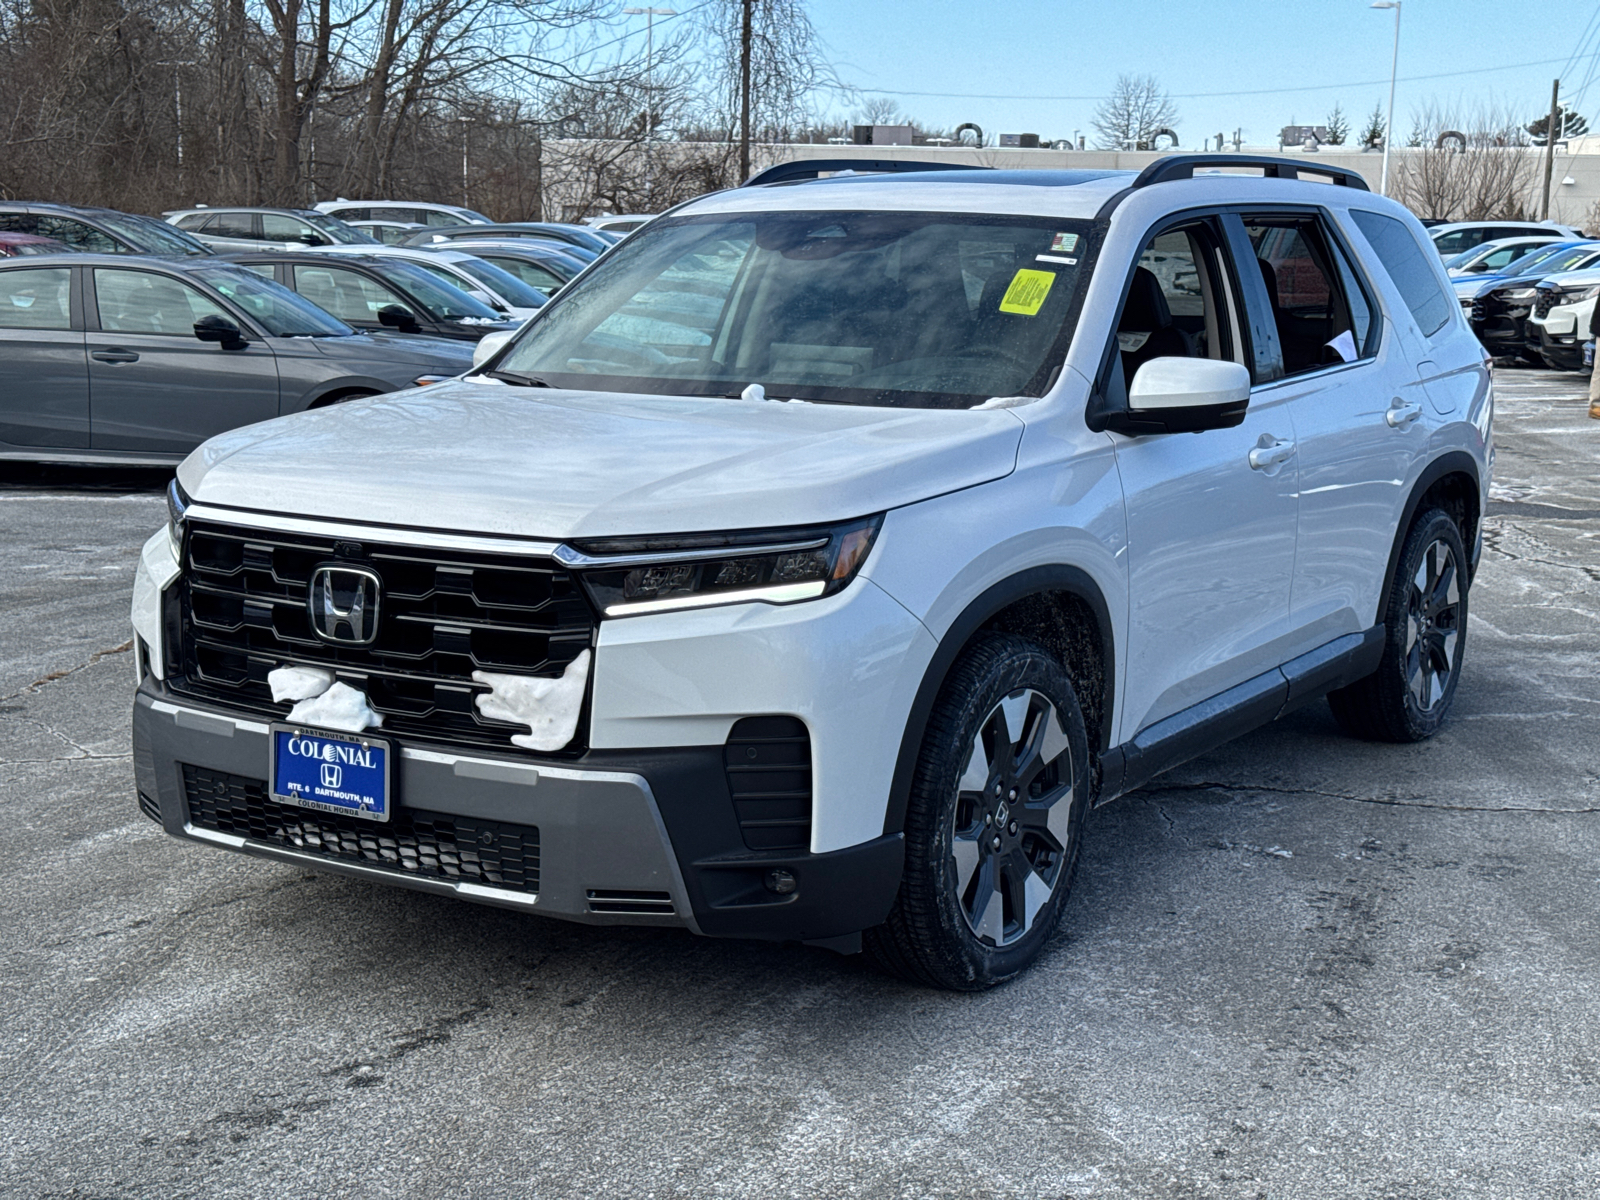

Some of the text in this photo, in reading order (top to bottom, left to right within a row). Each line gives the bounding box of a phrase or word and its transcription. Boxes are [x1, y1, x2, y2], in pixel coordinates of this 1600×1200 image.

[349, 735, 361, 743] MA
[288, 738, 377, 769] COLONIAL
[287, 782, 304, 792] RTE.
[315, 787, 361, 803] DARTMOUTH,
[363, 796, 375, 805] MA
[298, 799, 360, 816] COLONIAL HONDA
